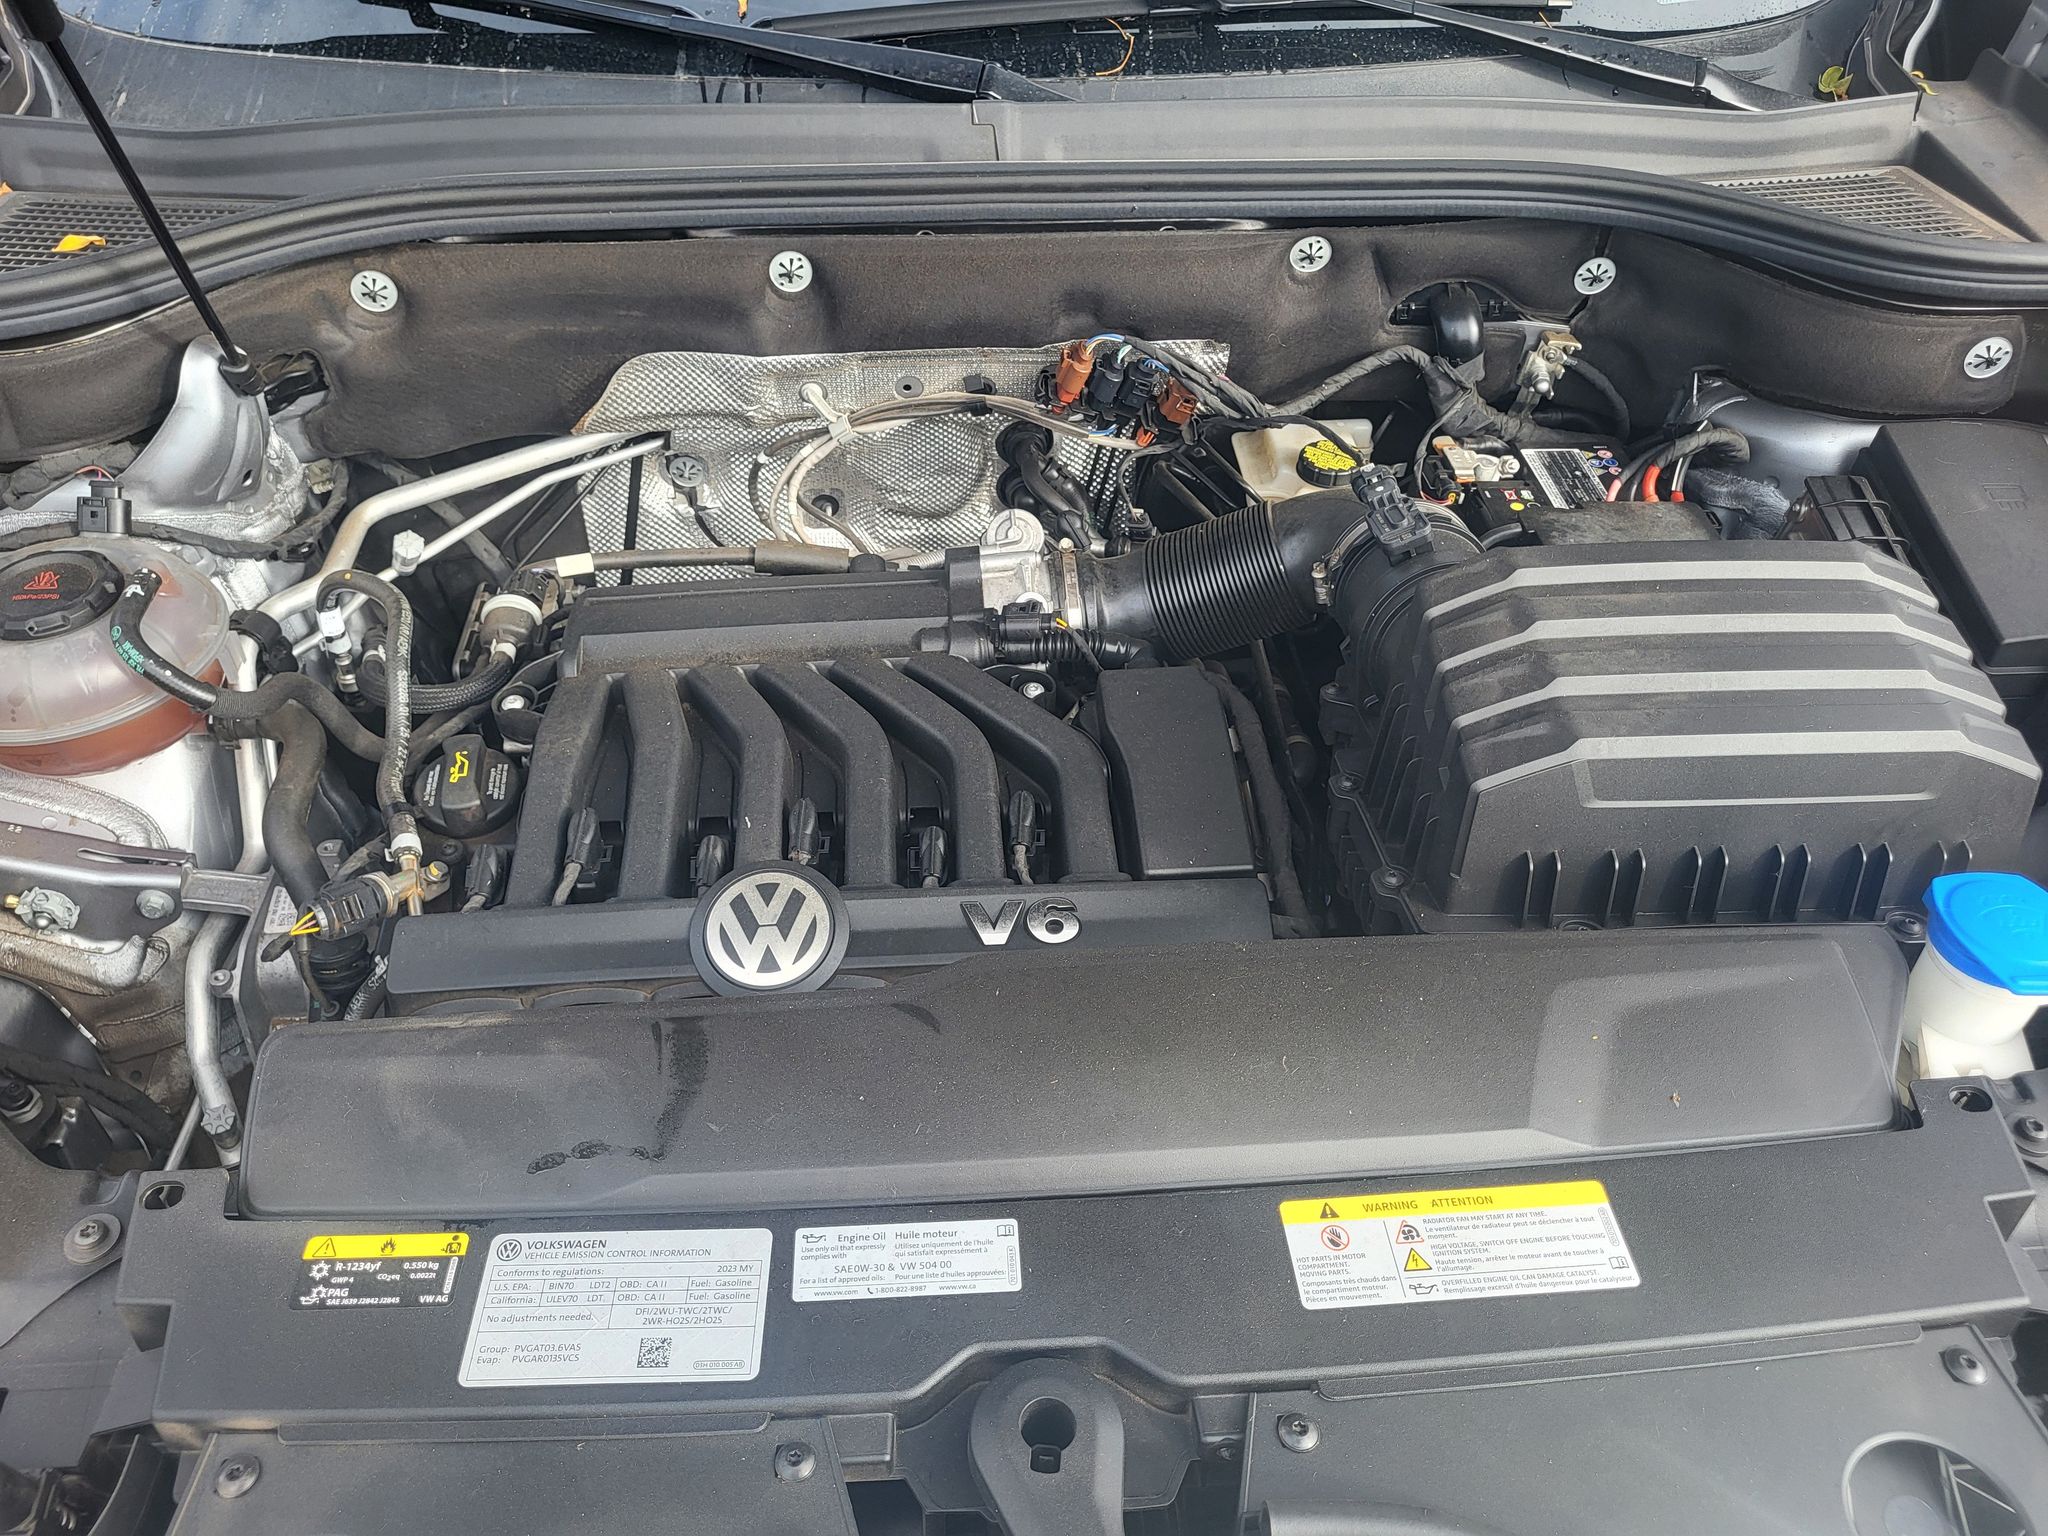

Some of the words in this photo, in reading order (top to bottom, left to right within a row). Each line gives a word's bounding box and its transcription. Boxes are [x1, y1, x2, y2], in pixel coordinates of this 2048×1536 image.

[960, 896, 1081, 946] V6
[1362, 1200, 1418, 1212] WARNING
[1431, 1196, 1494, 1208] ATTENTION
[1423, 1216, 1456, 1224] RADIATOR
[1434, 1224, 1470, 1232] ventilateur
[838, 1234, 870, 1244] Engine
[873, 1232, 886, 1240] Oil
[896, 1231, 920, 1240] Huile
[923, 1230, 958, 1238] moteur
[527, 1240, 607, 1250] VOLKSWAGEN
[856, 1244, 886, 1252] expressly
[921, 1241, 962, 1249] uniquement
[524, 1251, 560, 1260] VEHICLE
[562, 1250, 605, 1259] EMISSION
[650, 1249, 712, 1257] INFORMATION
[1433, 1249, 1462, 1257] IGNITION
[336, 1262, 382, 1272] R-1234yf
[428, 1261, 440, 1270] kg
[834, 1264, 886, 1274] SAE0W-30
[888, 1263, 896, 1272] &
[900, 1262, 916, 1270] VW
[920, 1262, 937, 1270] 504
[940, 1260, 952, 1268] 00
[498, 1268, 539, 1277] Conforms
[542, 1268, 550, 1276] to
[553, 1268, 604, 1278] regulations:
[966, 1270, 1006, 1278] approuvées:
[690, 1280, 711, 1288] Fuel:
[715, 1279, 752, 1287] Gasoline
[839, 1276, 870, 1284] approved
[1442, 1278, 1482, 1286] OVERFILLED
[1537, 1272, 1564, 1280] DAMAGE
[494, 1283, 510, 1291] U.S.
[1302, 1280, 1342, 1288] Composants
[1444, 1286, 1486, 1294] Remplissage
[1538, 1280, 1574, 1288] dangereux
[327, 1288, 350, 1297] PAG
[876, 1286, 926, 1294] 1-800-822-8987
[1312, 1286, 1360, 1296] compartiment
[420, 1295, 434, 1303] VW
[436, 1294, 448, 1302] AG
[490, 1296, 536, 1304] California:
[714, 1292, 750, 1300] Gasoline
[635, 1306, 732, 1316] DFI/2WU-TWC/2TWC/
[501, 1314, 556, 1324] adjustments
[480, 1345, 510, 1355] Group:
[514, 1344, 581, 1352] PVGAT03.6VAS
[476, 1356, 501, 1365] Evap:
